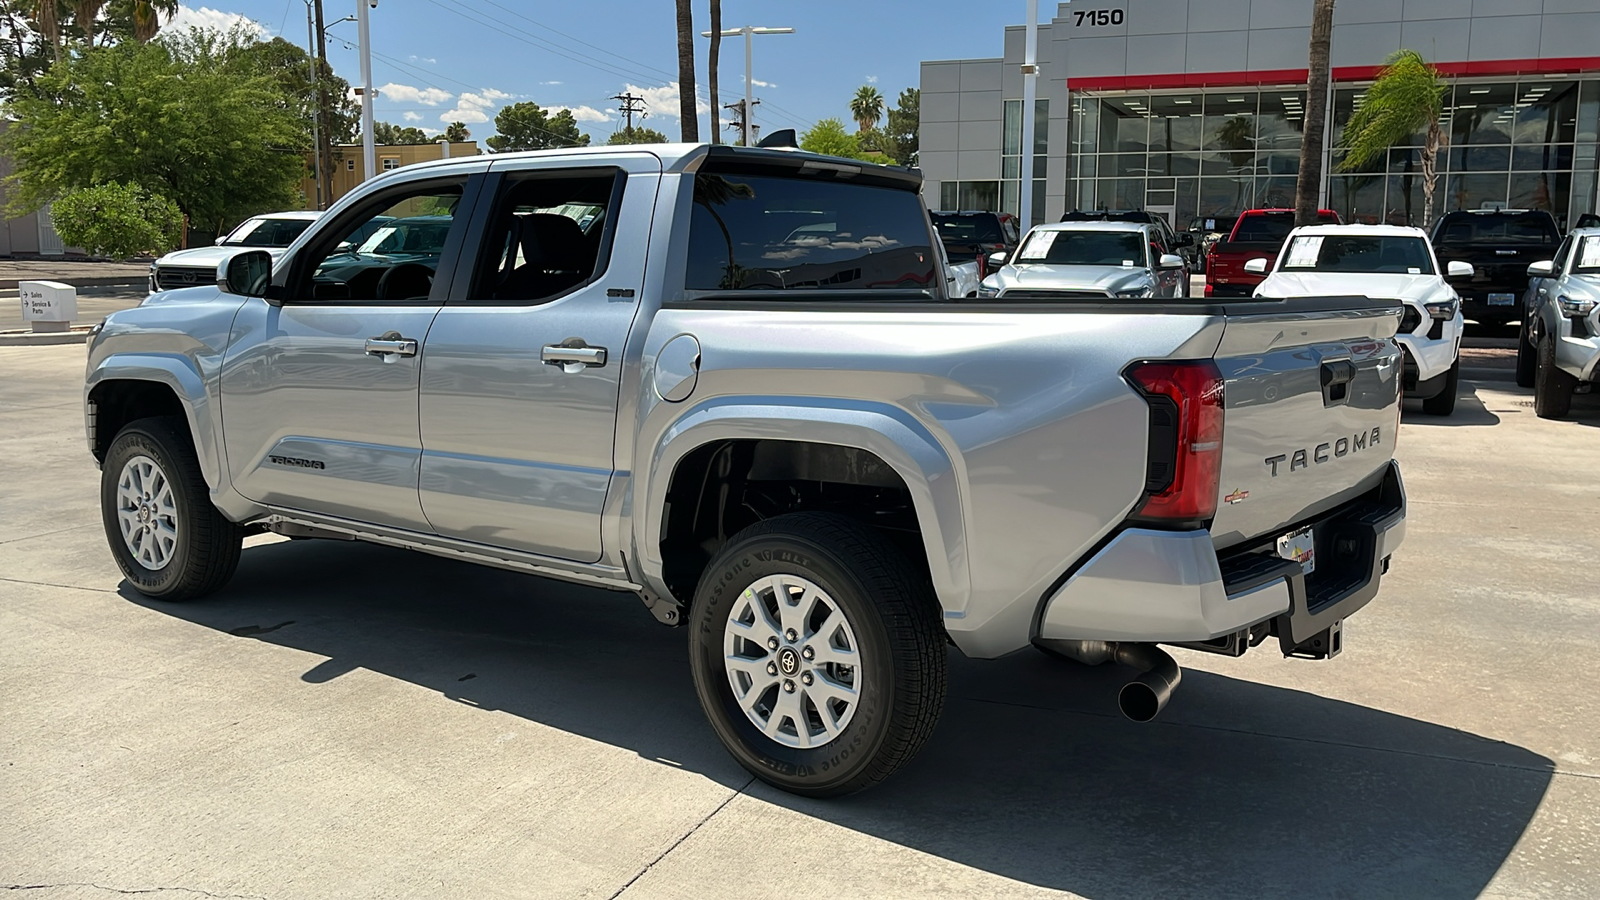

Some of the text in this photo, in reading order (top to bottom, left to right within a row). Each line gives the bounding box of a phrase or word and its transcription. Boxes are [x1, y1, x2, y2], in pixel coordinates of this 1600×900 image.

[1073, 9, 1124, 27] 7150
[268, 454, 326, 470] TACOMA
[1264, 426, 1381, 477] TACOMA
[699, 557, 752, 635] Firestone
